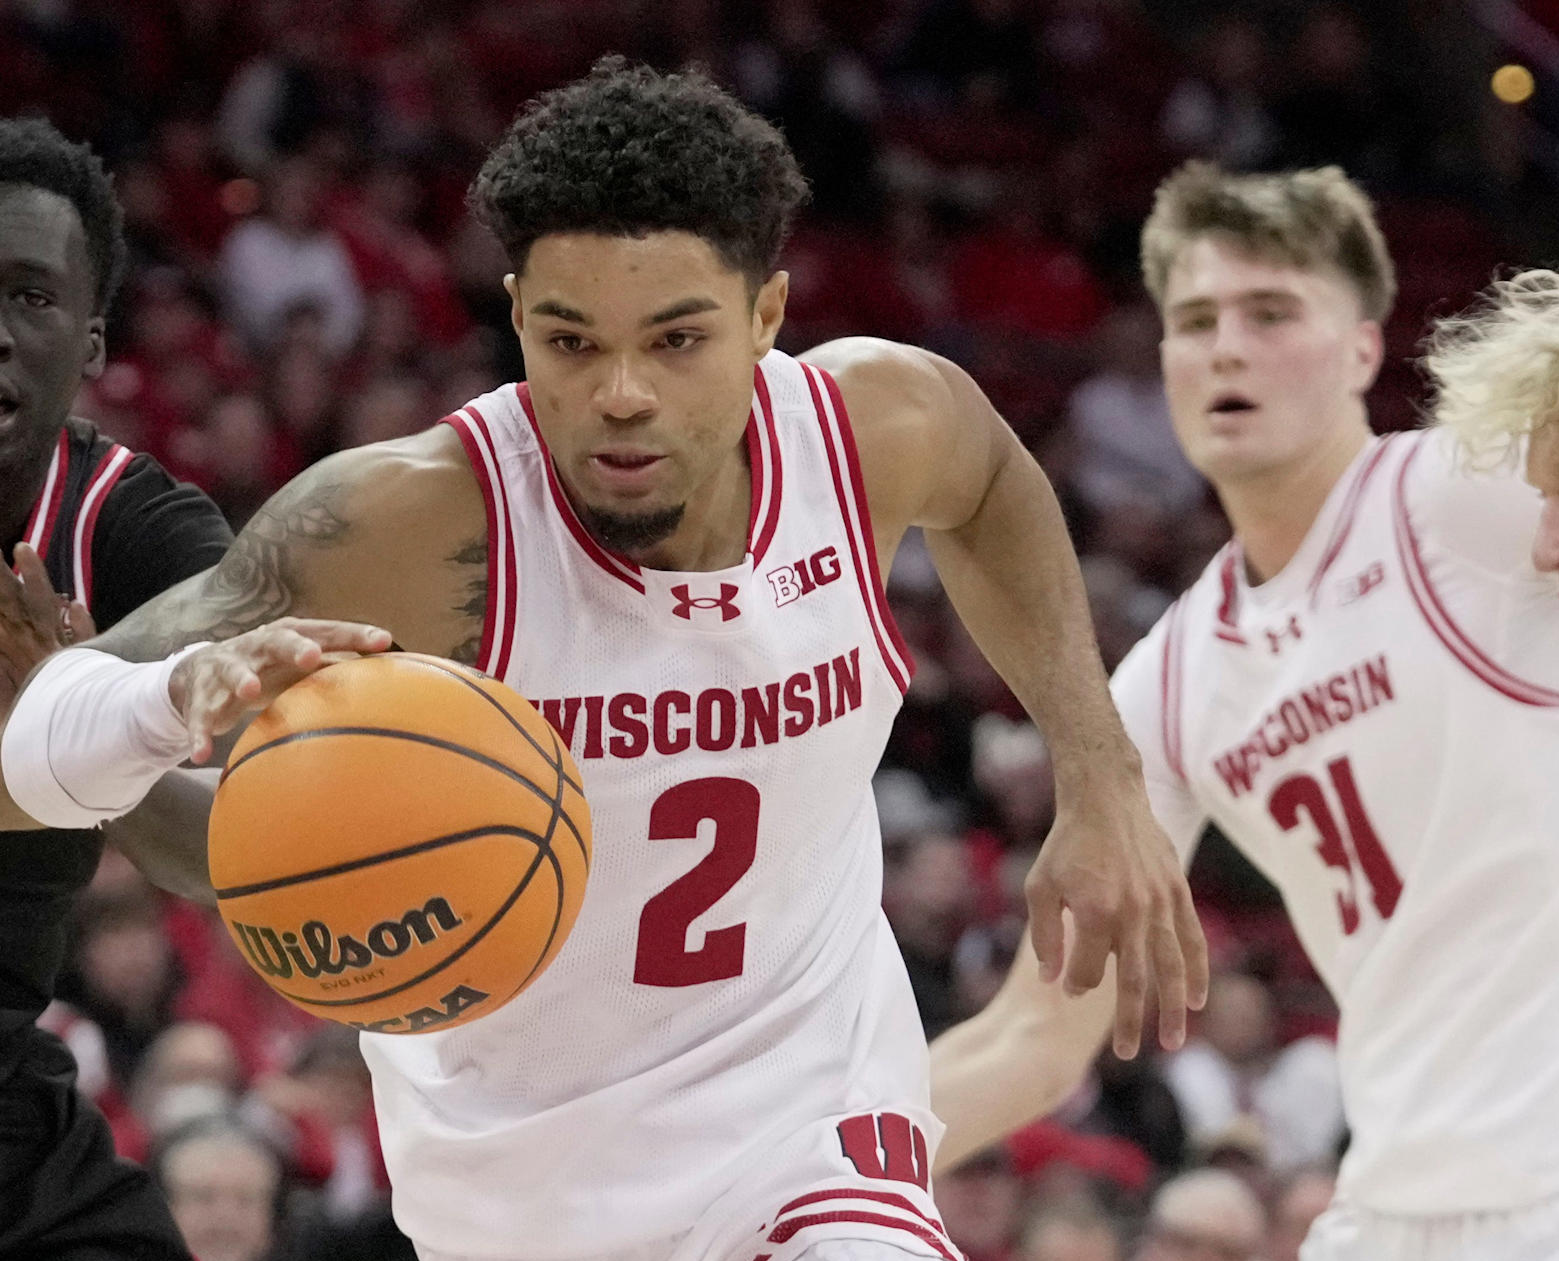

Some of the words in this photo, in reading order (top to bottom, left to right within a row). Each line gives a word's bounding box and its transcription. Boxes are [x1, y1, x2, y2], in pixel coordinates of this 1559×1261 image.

[633, 777, 761, 987] 2
[1267, 755, 1405, 936] 31
[231, 896, 463, 979] Wilson
